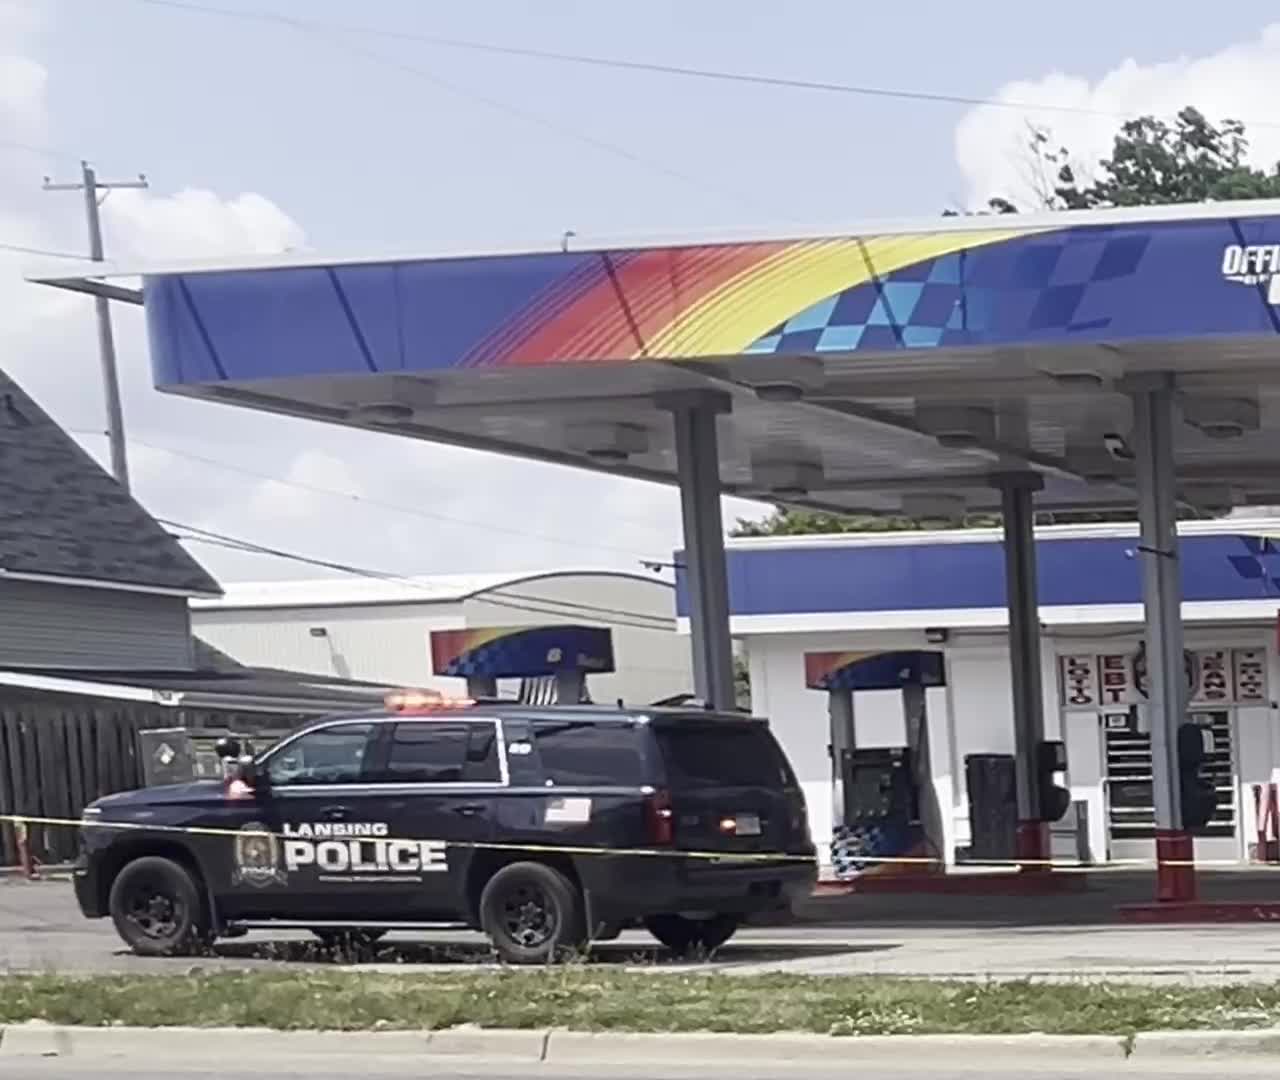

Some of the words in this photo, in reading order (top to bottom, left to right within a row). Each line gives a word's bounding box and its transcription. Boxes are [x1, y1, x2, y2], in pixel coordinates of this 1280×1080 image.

[1103, 654, 1127, 702] EBT
[283, 822, 389, 837] LANSING
[283, 839, 449, 872] POLICE
